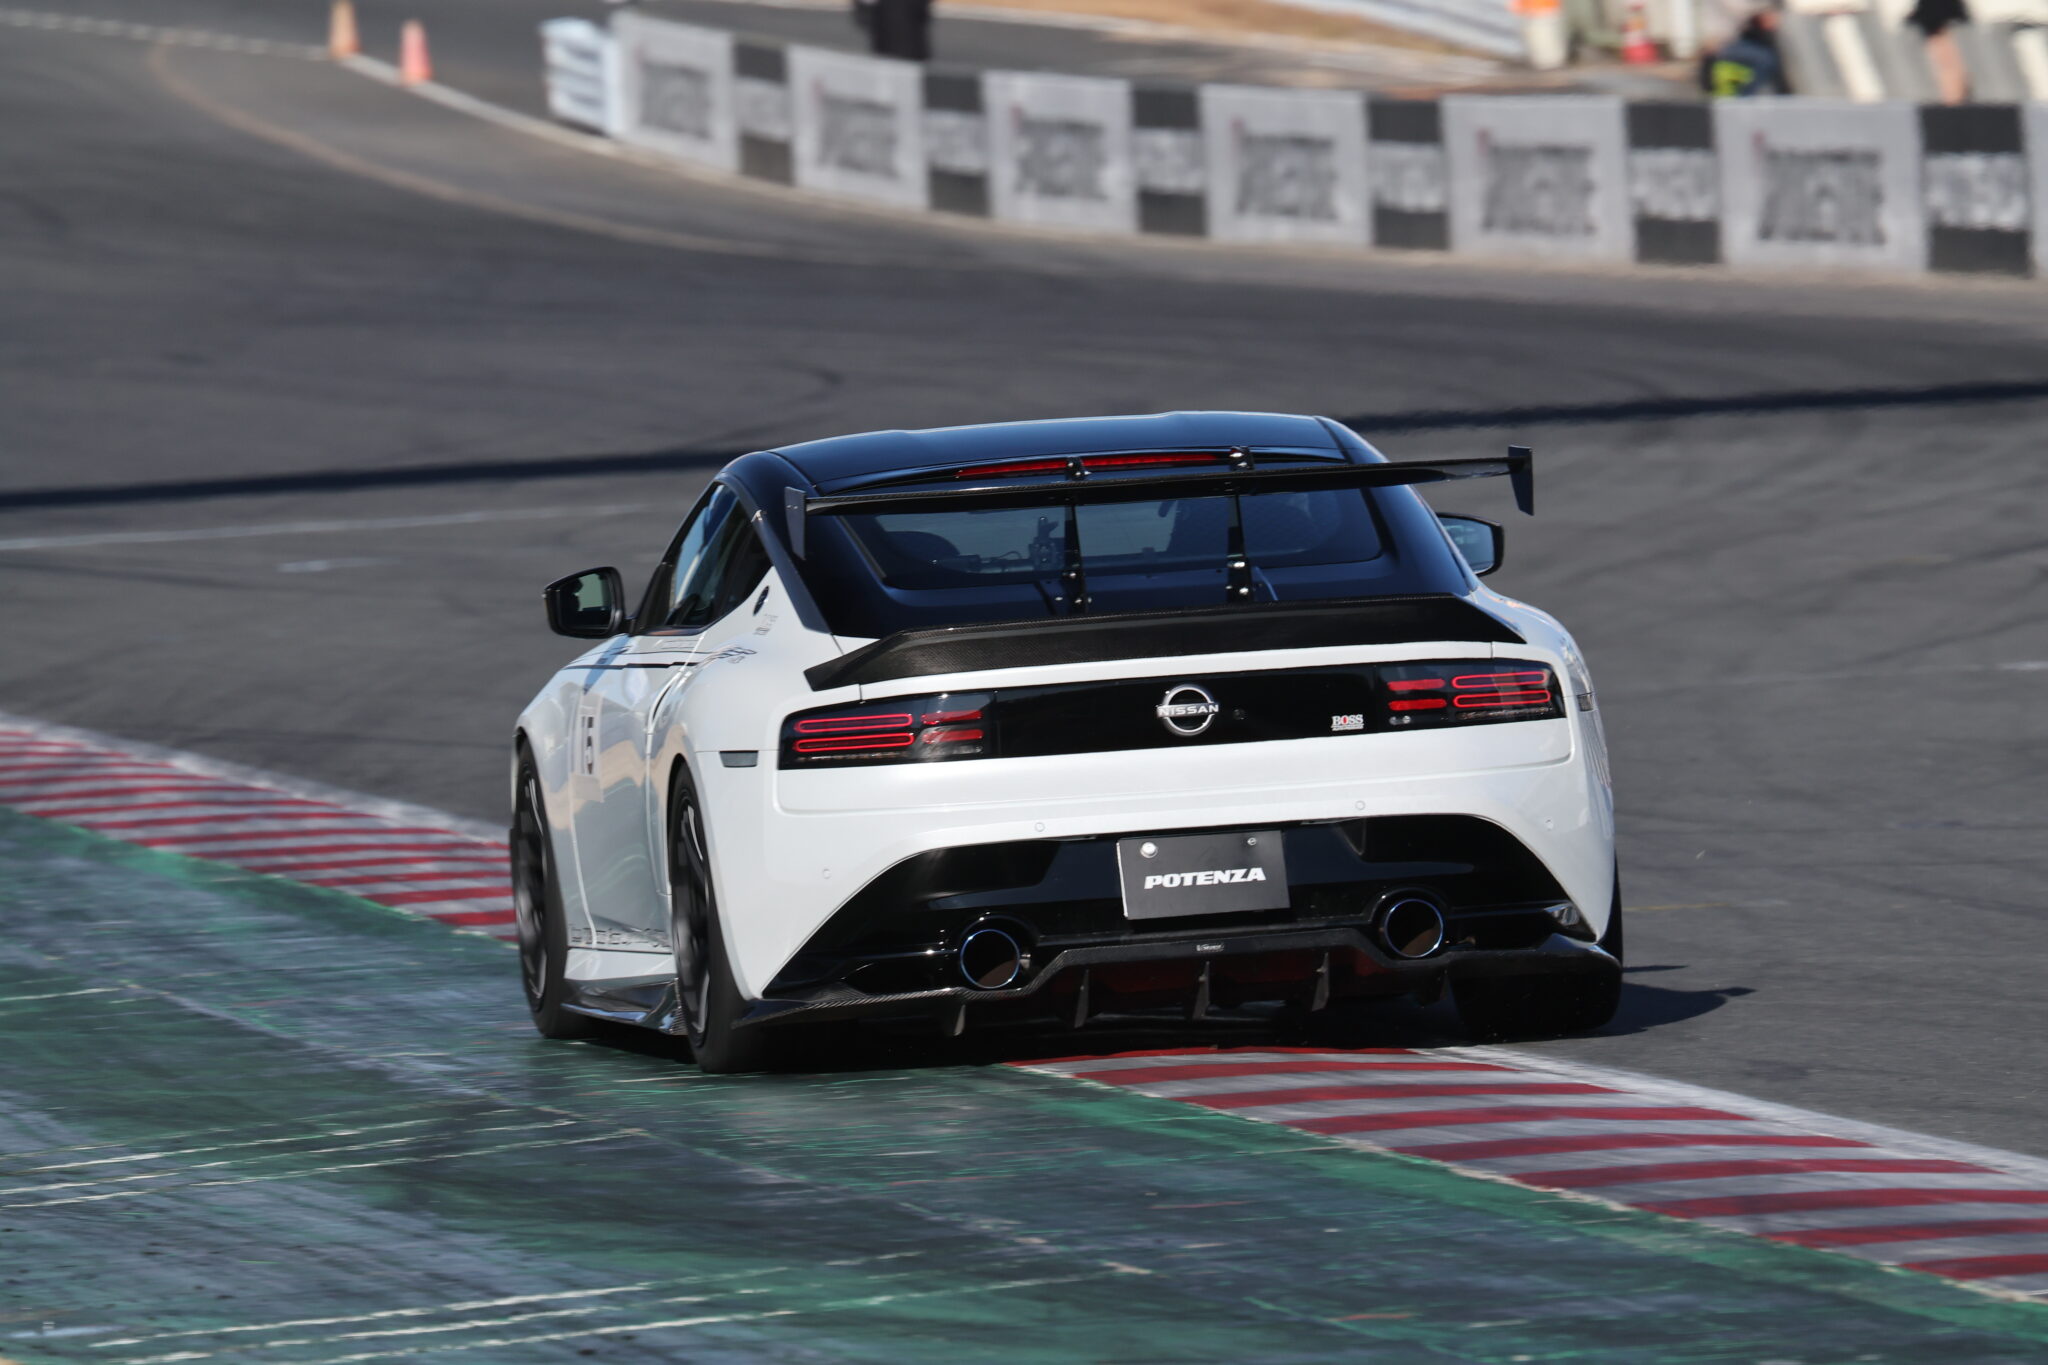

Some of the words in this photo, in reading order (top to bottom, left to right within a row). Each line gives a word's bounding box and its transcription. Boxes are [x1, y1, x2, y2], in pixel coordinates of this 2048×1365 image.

[1157, 705, 1219, 716] NISSAN
[1332, 714, 1363, 725] BOSS
[1144, 867, 1266, 889] POTENZA
